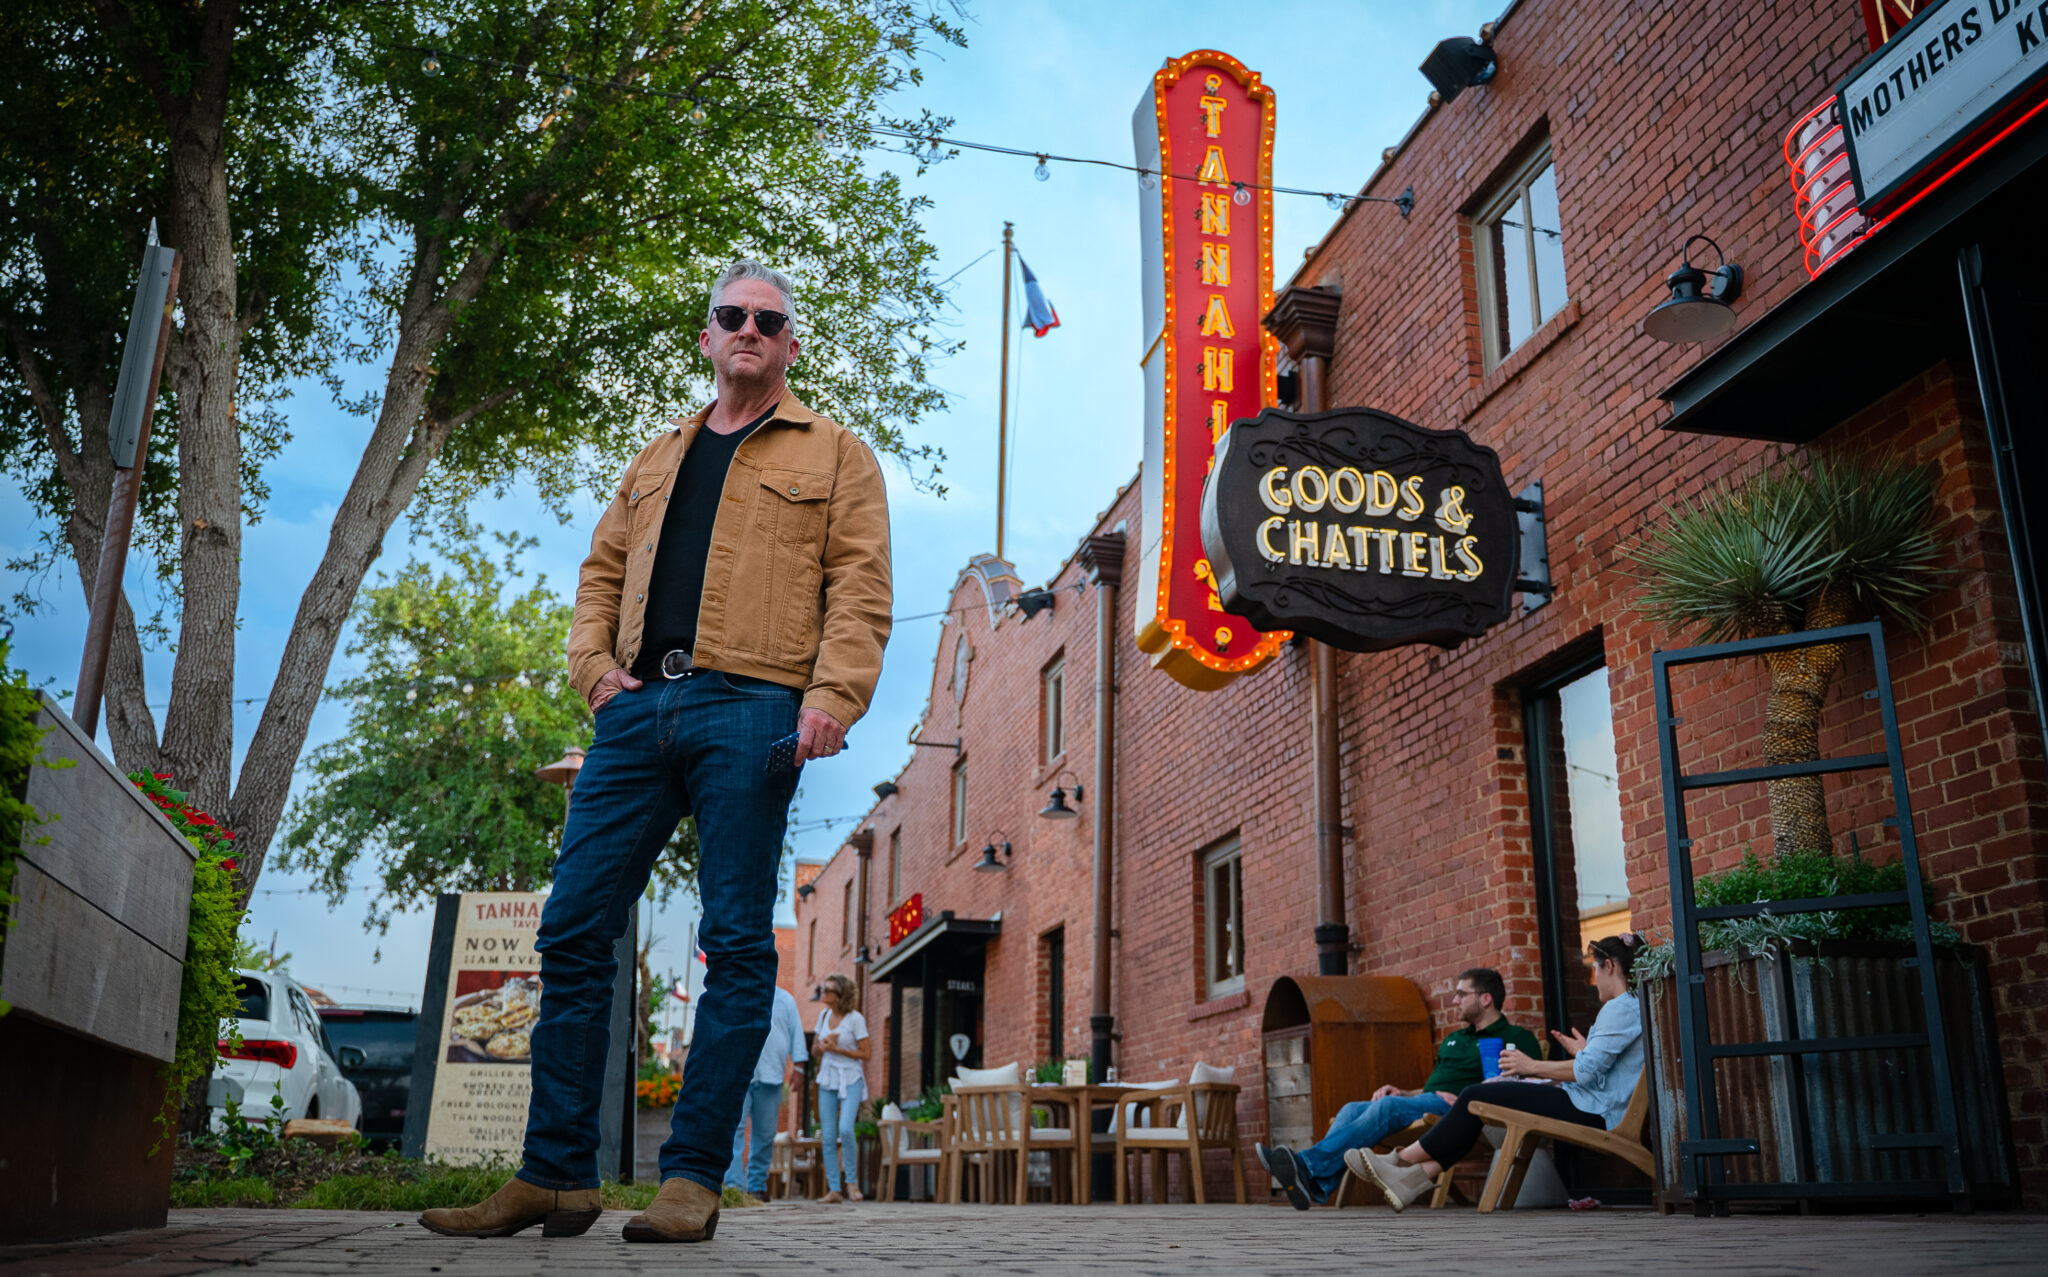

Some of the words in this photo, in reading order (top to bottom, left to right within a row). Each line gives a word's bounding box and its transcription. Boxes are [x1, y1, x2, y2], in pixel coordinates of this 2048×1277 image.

[1850, 7, 1982, 137] MOTHERS
[1258, 465, 1425, 521] GOODS
[1434, 485, 1474, 535] &
[1256, 516, 1483, 582] CHATTELS
[475, 901, 546, 920] TANNA
[513, 919, 541, 929] TAVE
[465, 937, 520, 951] NOW
